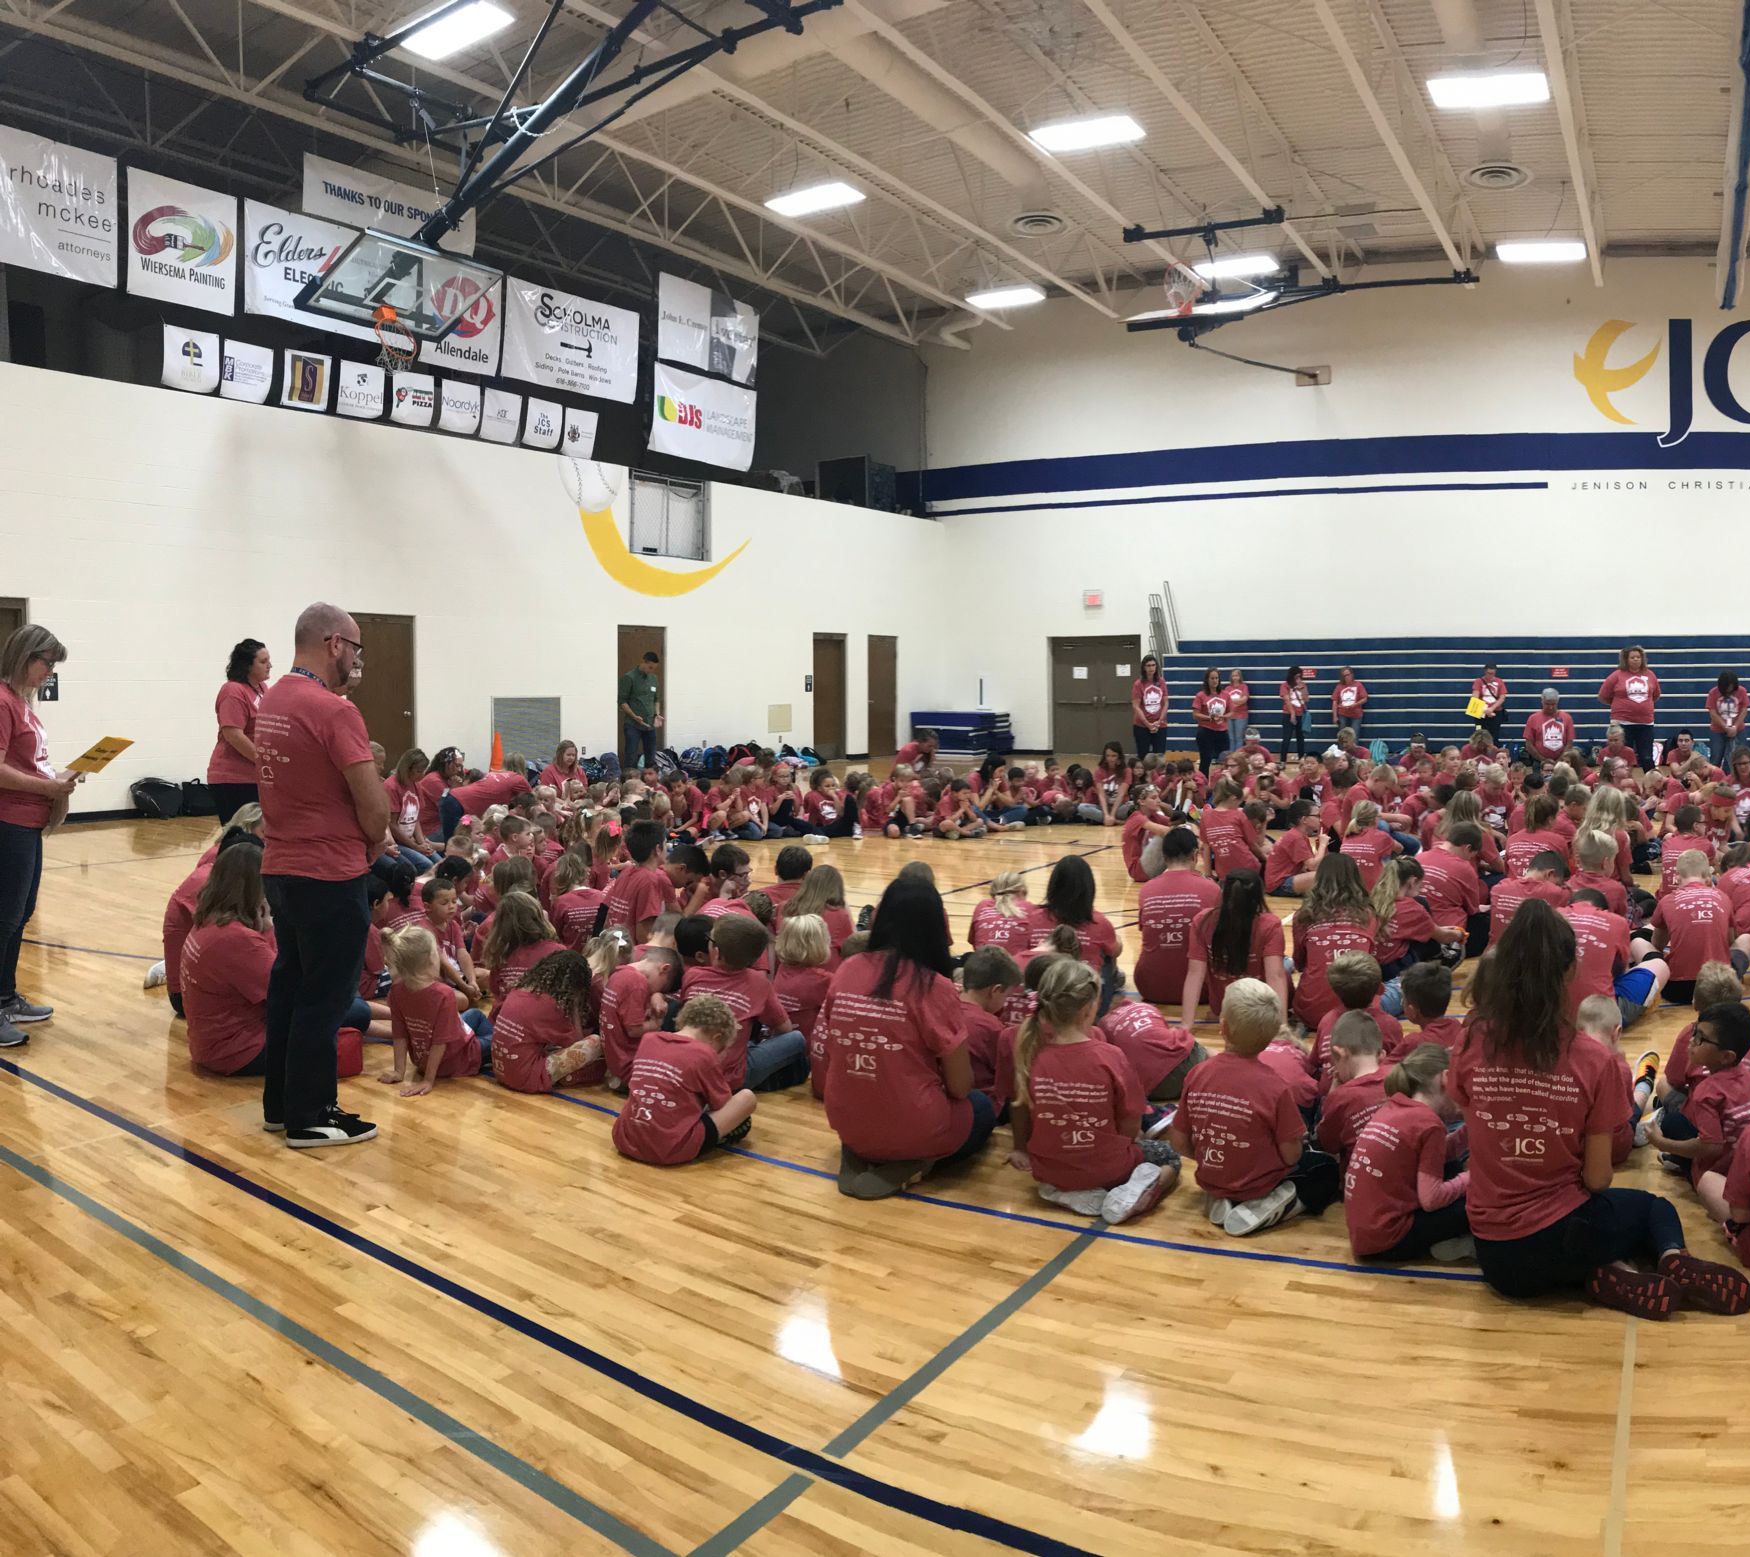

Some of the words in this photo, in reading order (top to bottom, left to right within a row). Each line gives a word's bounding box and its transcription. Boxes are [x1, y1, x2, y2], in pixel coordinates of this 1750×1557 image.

[9, 165, 105, 204] rhoades
[322, 181, 365, 206] THANKS
[367, 195, 382, 210] TO
[383, 200, 405, 217] OUR
[38, 201, 112, 233] mckee
[57, 240, 111, 262] attorneys
[252, 223, 328, 268] Elders
[434, 340, 489, 363] Allendale
[545, 353, 562, 363] Decks
[535, 362, 554, 372] Siding
[412, 399, 433, 408] PIZZA
[442, 396, 480, 413] Noordyk
[537, 418, 551, 428] JCS
[533, 425, 554, 437] Staff
[1571, 481, 1647, 490] JENISON
[994, 930, 1010, 939] JCS
[1167, 931, 1183, 943] JCS
[855, 1053, 877, 1070] JCS
[1510, 1077, 1527, 1085] good
[1535, 1080, 1551, 1088] those
[1566, 1085, 1580, 1093] love
[1561, 1074, 1574, 1083] God
[1531, 1089, 1549, 1098] called
[1549, 1094, 1578, 1103] according
[1072, 1130, 1096, 1145] JCS
[1204, 1146, 1225, 1163] JCS
[1514, 1138, 1546, 1156] JCS
